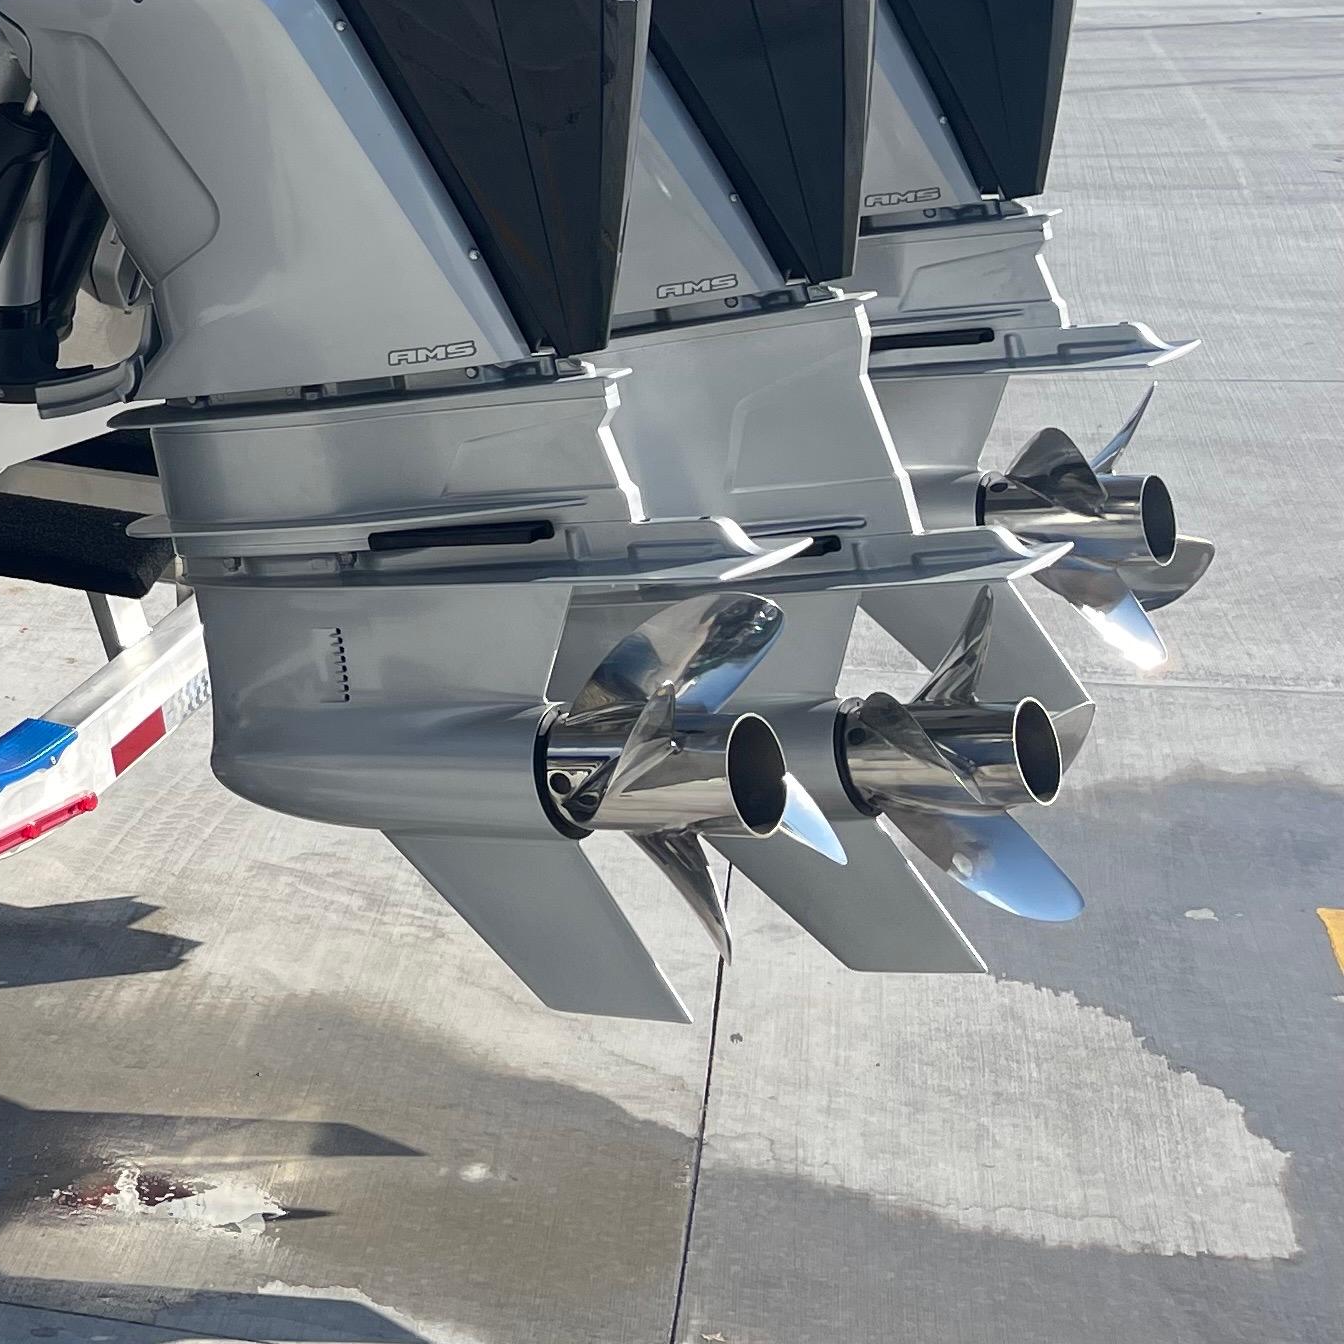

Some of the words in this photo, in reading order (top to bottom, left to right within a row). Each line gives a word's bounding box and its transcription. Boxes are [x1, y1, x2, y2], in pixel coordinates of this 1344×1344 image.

[864, 186, 942, 208] AMS
[657, 273, 739, 299] AMS
[388, 340, 477, 366] AMS
